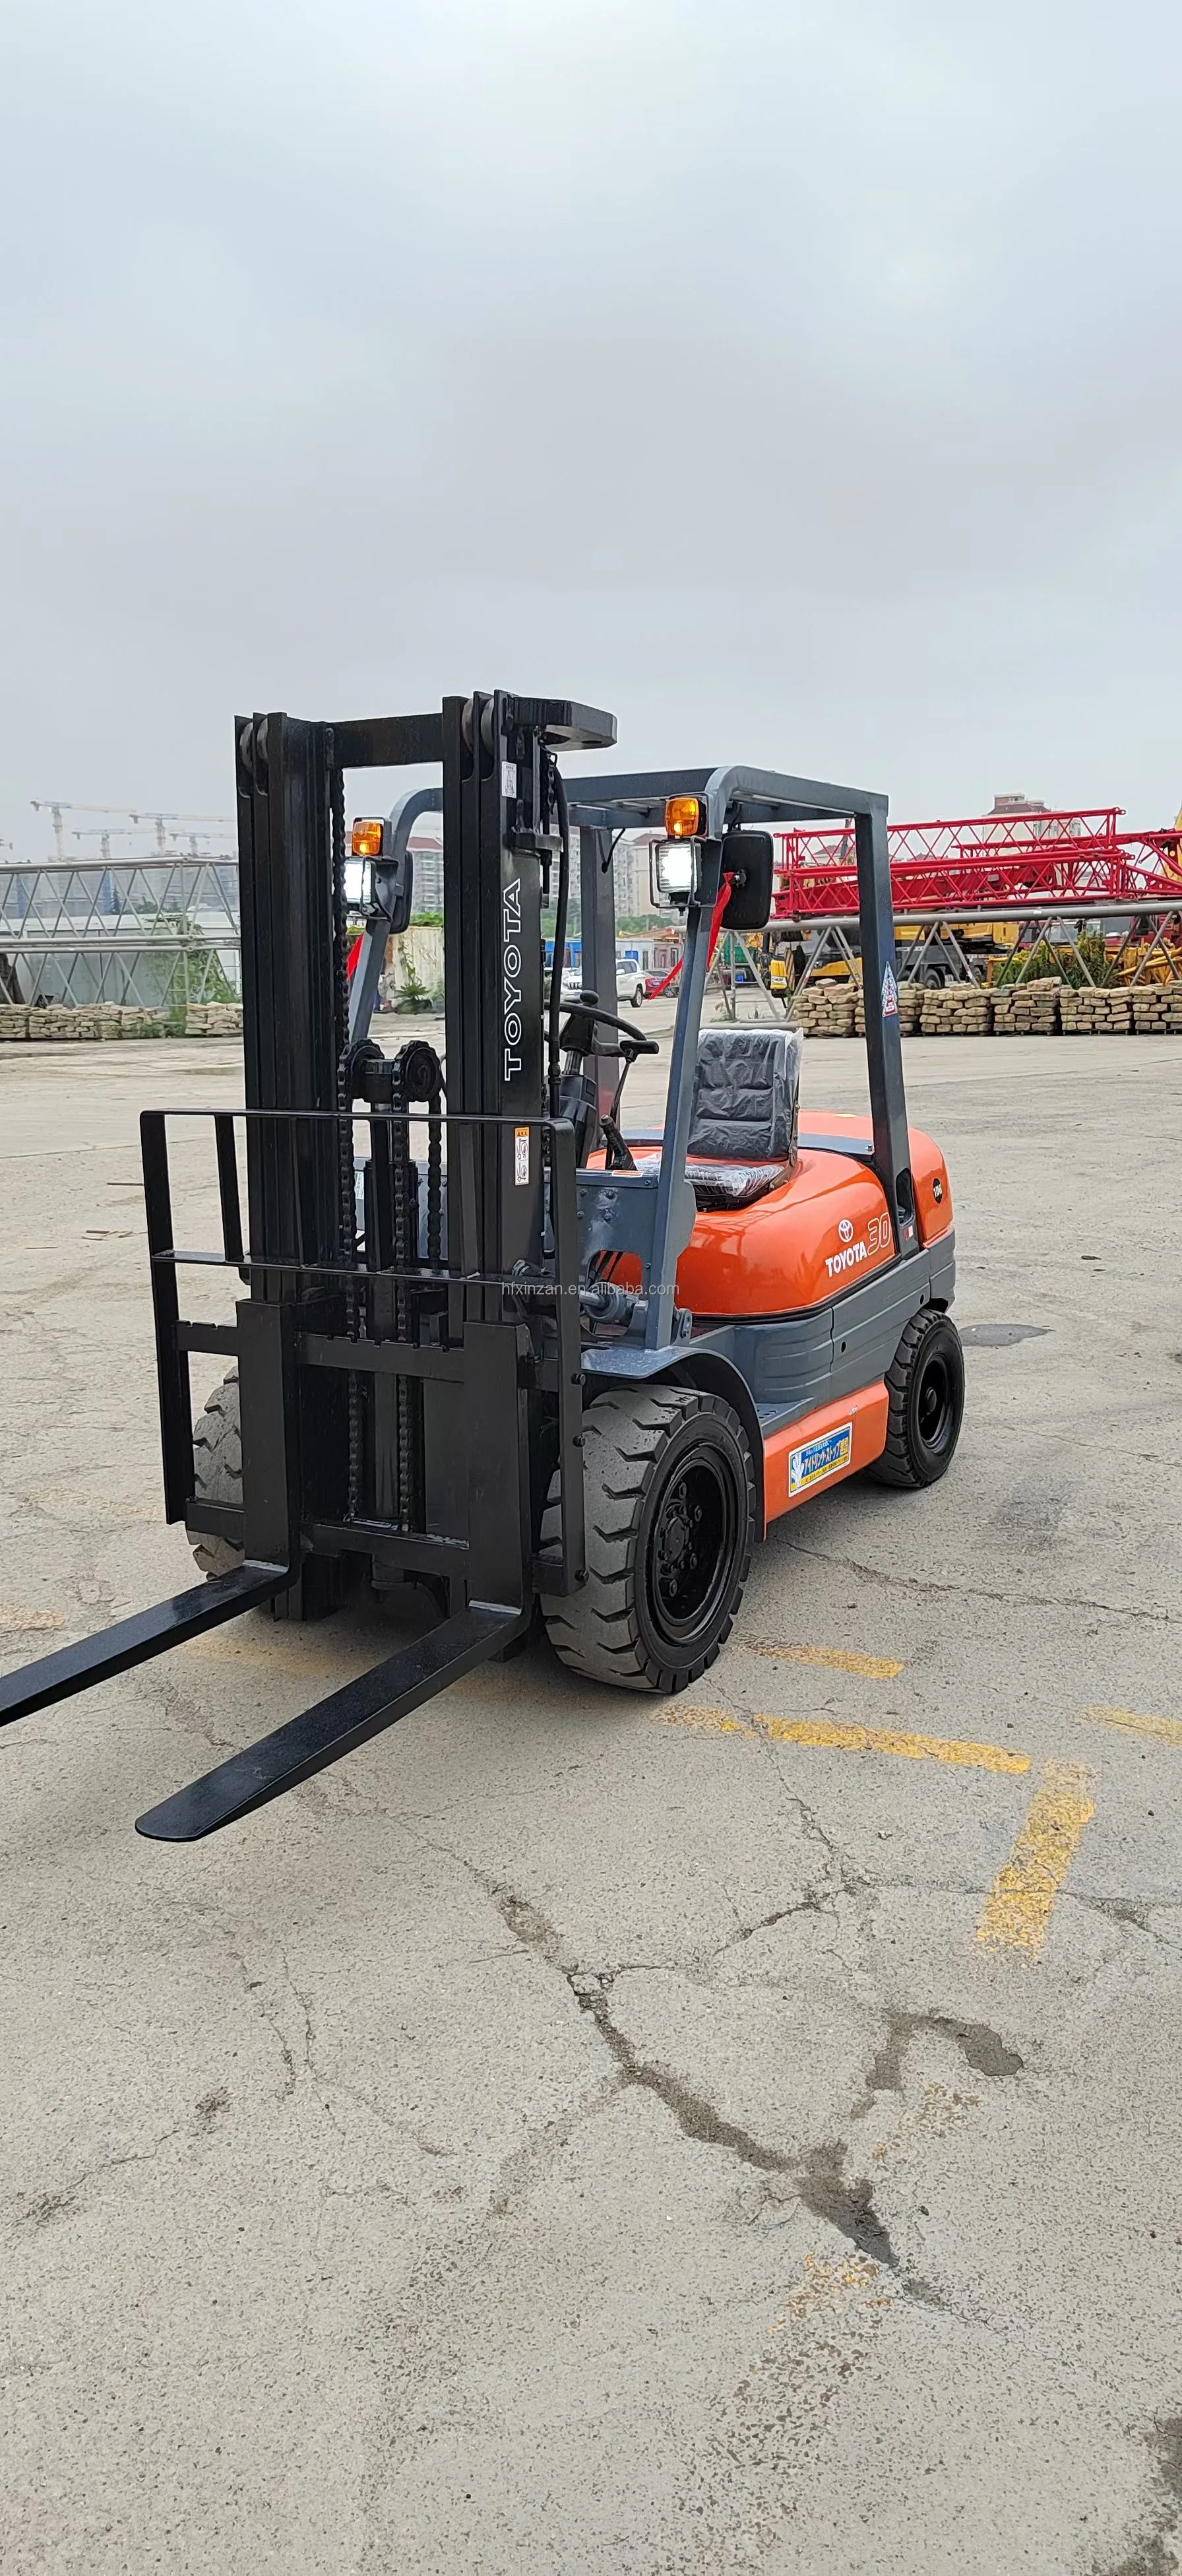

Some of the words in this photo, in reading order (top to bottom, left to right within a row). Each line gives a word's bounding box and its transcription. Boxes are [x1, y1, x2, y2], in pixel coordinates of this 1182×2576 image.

[503, 878, 522, 1081] TOYOTA
[825, 1241, 867, 1277] TOYOTA
[867, 1212, 891, 1256] 30
